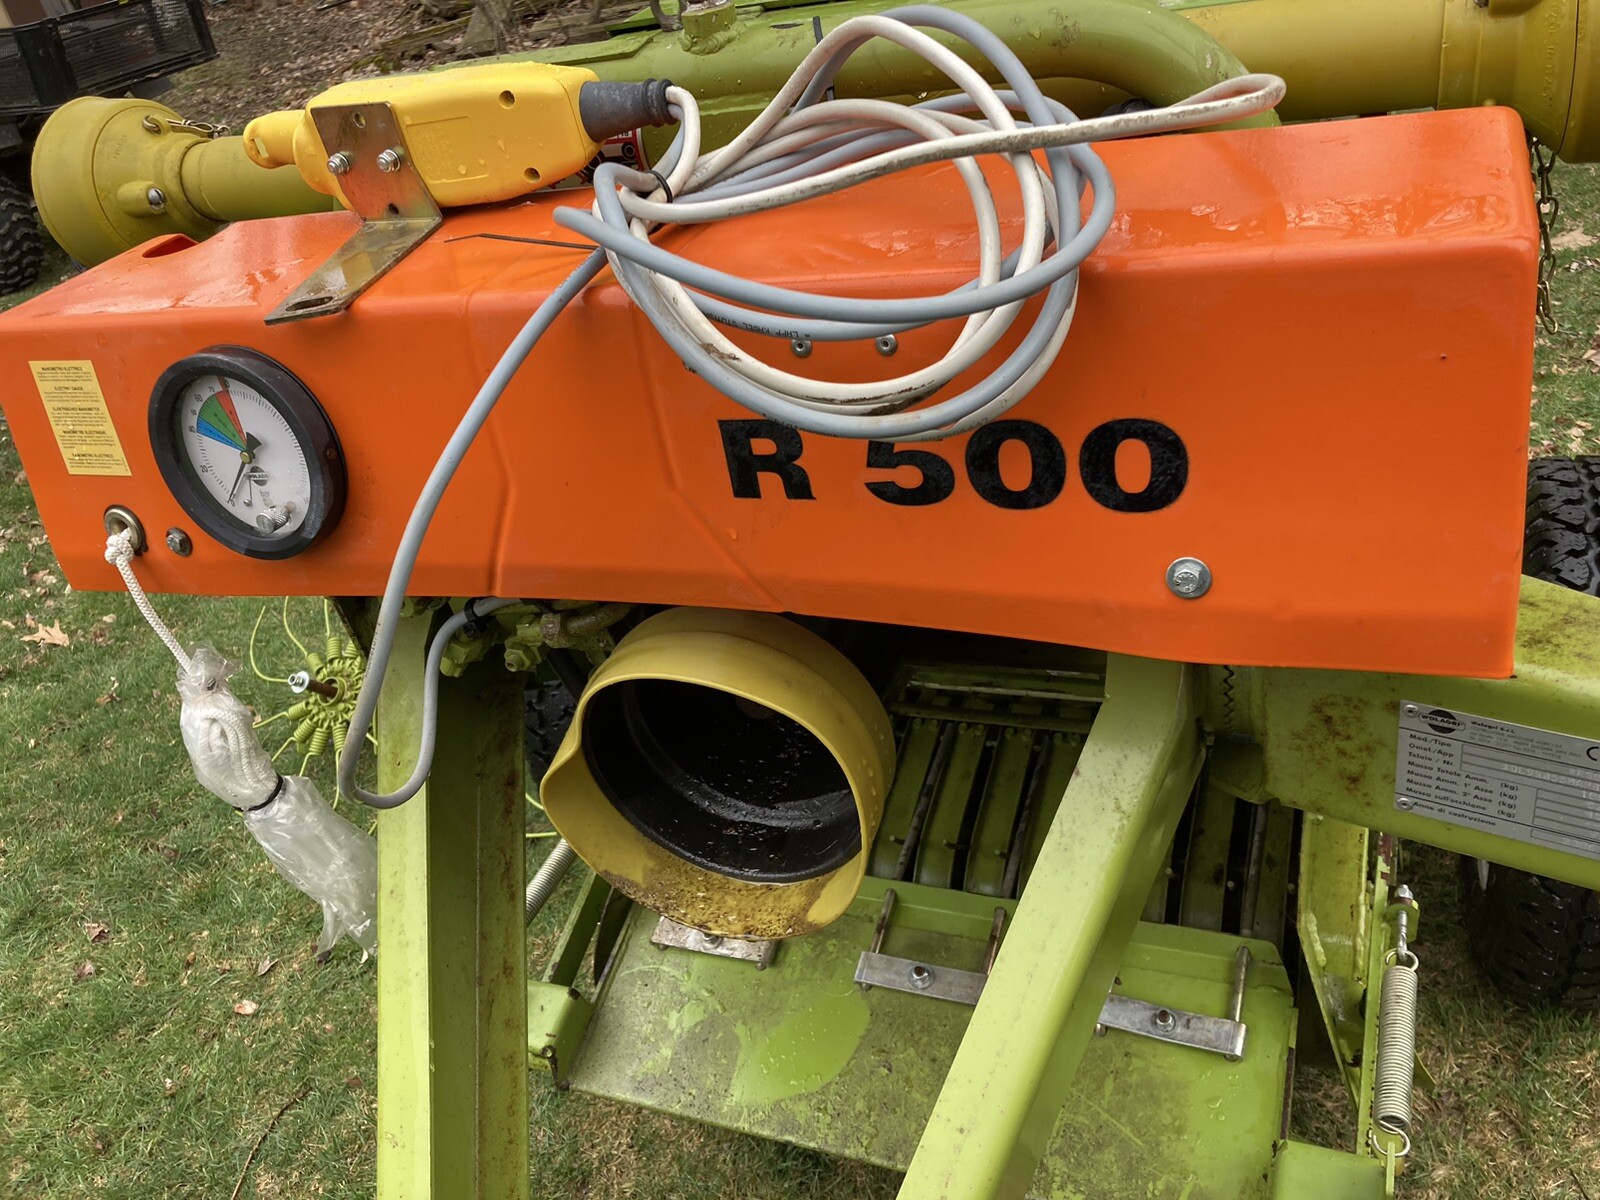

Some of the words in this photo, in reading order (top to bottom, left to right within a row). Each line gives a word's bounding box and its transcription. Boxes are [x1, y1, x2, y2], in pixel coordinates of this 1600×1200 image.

[717, 419, 817, 500] R
[864, 417, 1190, 513] 500
[1421, 713, 1461, 728] WOLAGRI
[1500, 782, 1519, 792] (kg)
[1499, 791, 1518, 801] (kg)
[1498, 800, 1517, 810] (kg)
[1497, 809, 1516, 819] (kg)
